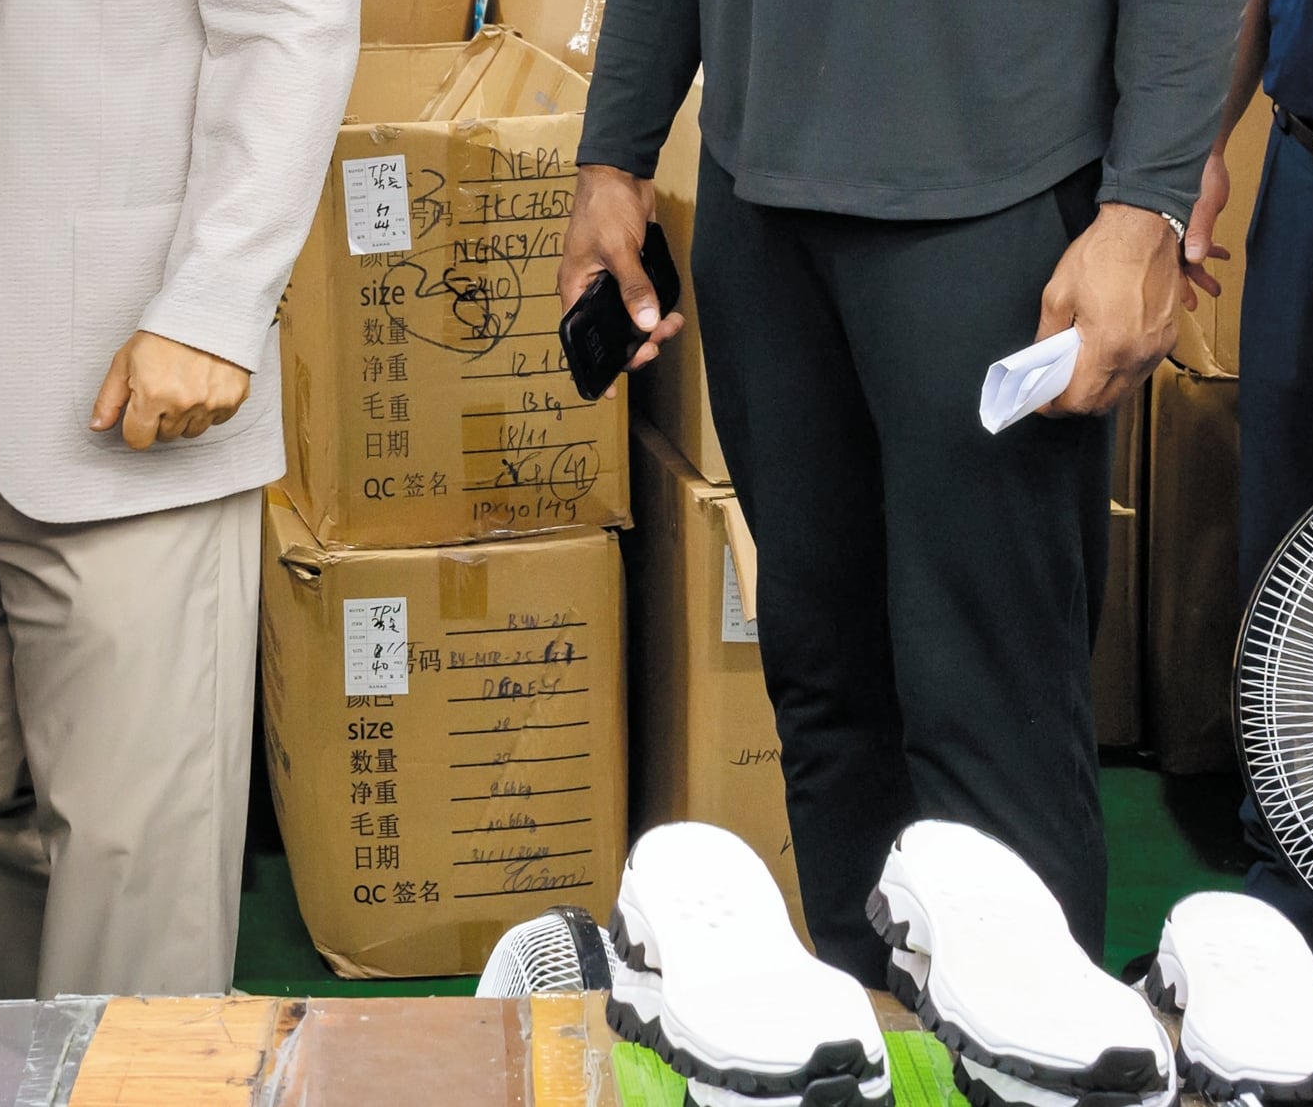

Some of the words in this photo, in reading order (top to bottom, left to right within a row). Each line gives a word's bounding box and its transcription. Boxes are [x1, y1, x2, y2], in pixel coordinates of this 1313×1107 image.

[360, 279, 406, 307] size
[363, 317, 409, 346] 数量
[362, 352, 408, 383] 净重
[362, 392, 410, 422] 毛重
[365, 430, 409, 459] 日期
[364, 477, 396, 500] QC
[403, 471, 448, 498] 签名
[348, 717, 394, 741] size
[350, 748, 398, 775] 数量
[350, 779, 398, 805] 净重
[350, 812, 401, 839] 毛重
[355, 844, 399, 870] 日期
[353, 884, 387, 905] QC
[392, 880, 440, 904] 签名
